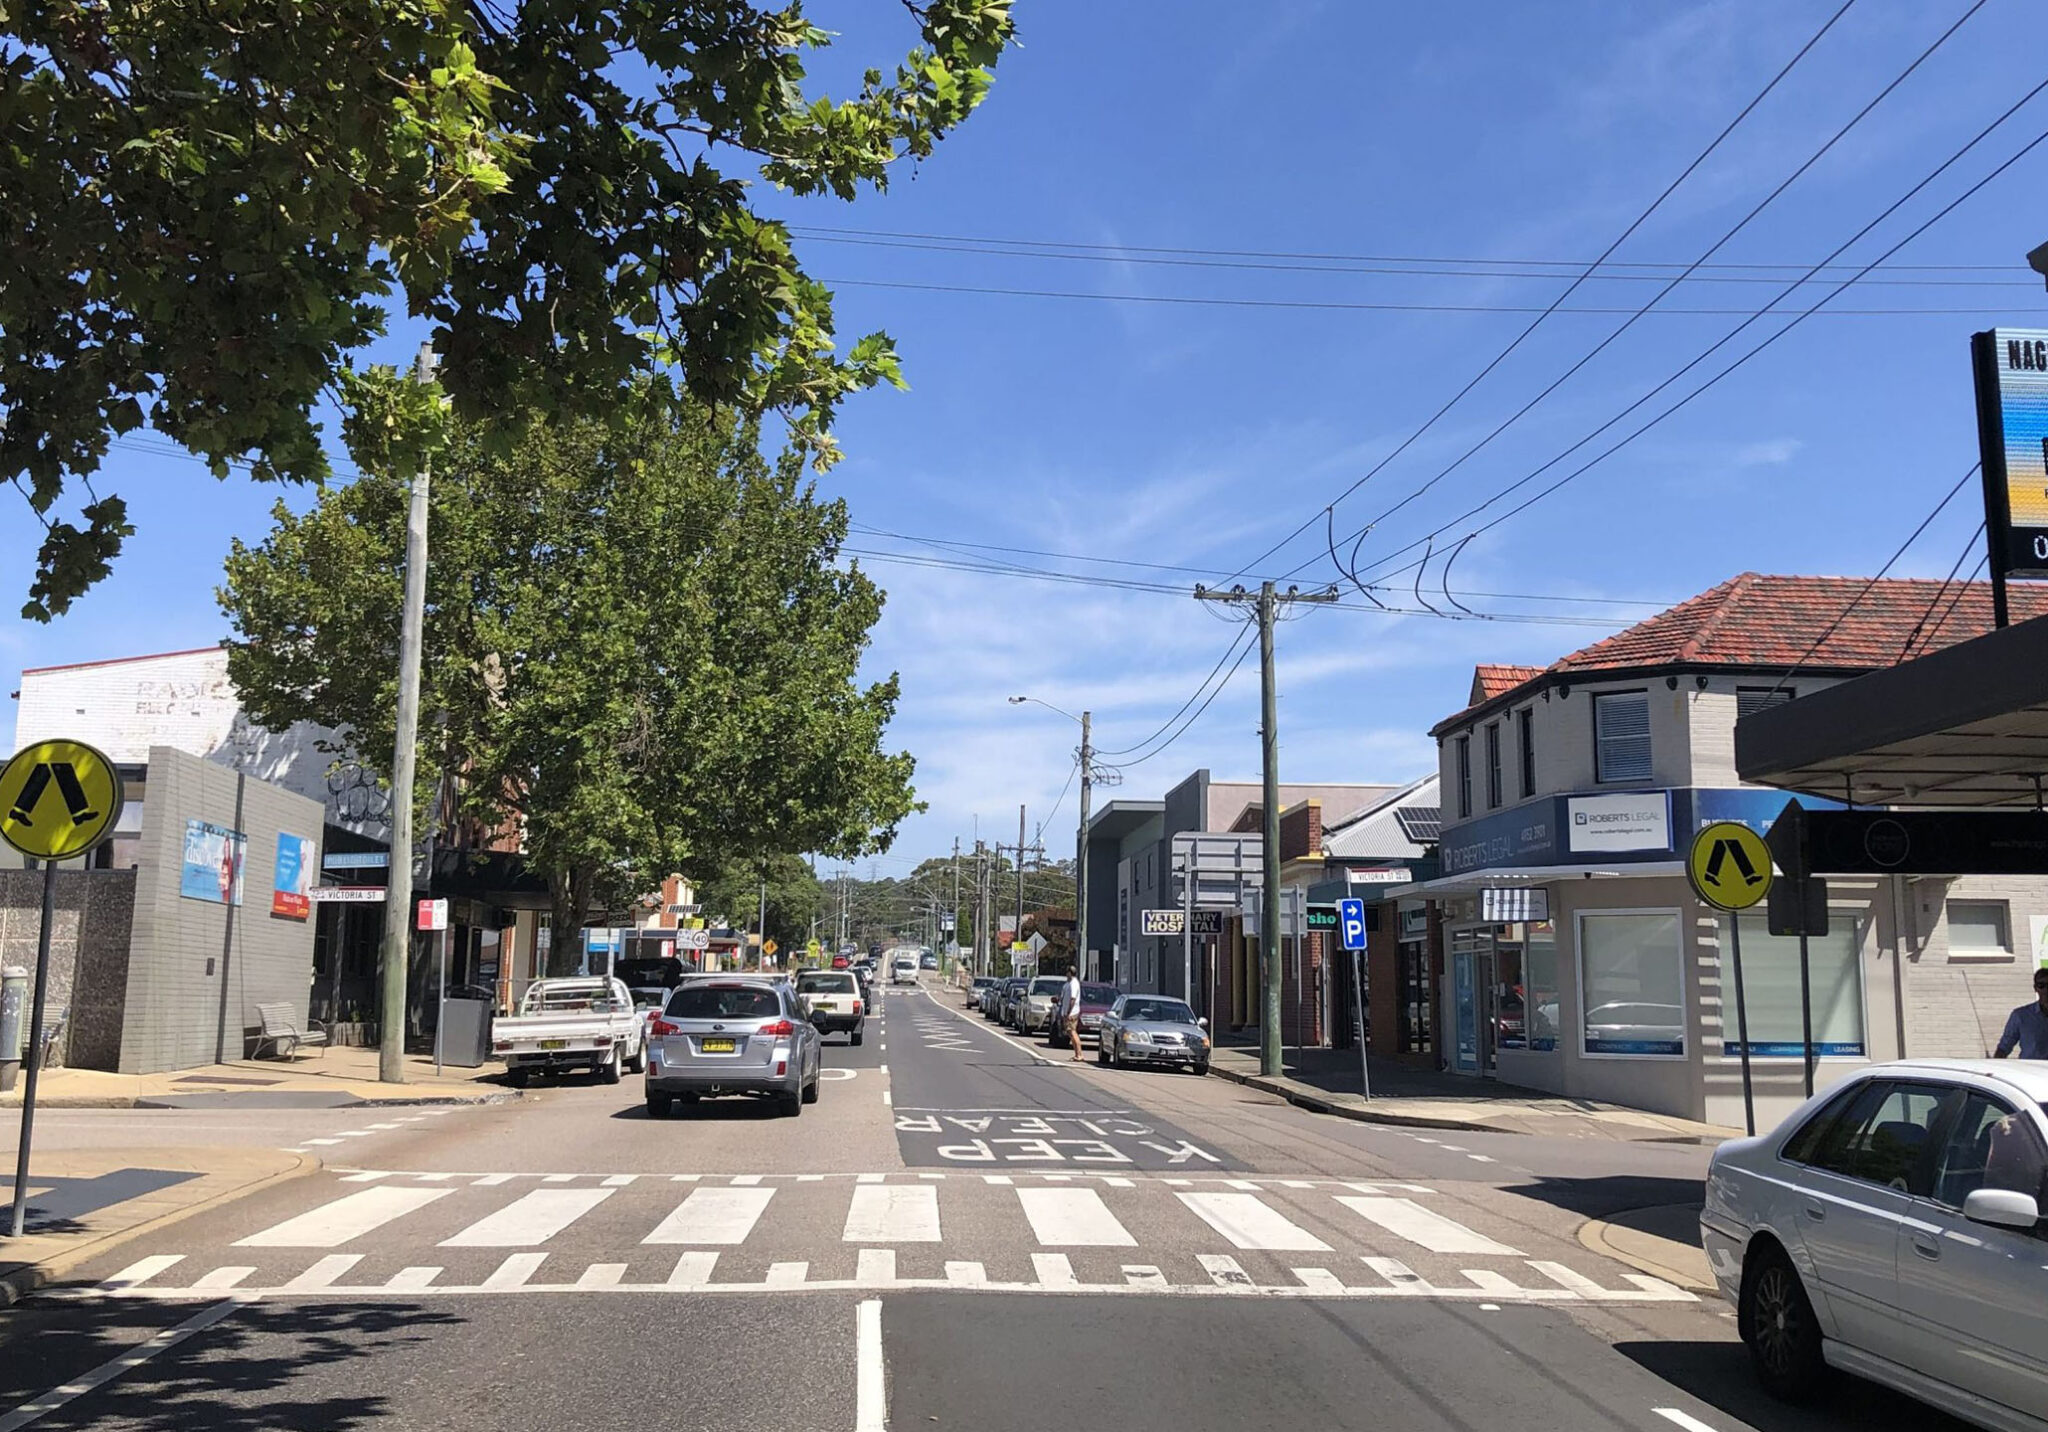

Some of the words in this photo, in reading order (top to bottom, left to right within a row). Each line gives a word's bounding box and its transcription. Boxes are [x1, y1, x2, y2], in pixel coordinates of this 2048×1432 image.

[2007, 339, 2048, 372] NAG
[1589, 812, 1630, 823] ROBERTS
[1631, 811, 1661, 822] LEGAL
[1454, 841, 1487, 869] ROBERTS
[1488, 834, 1515, 861] LEGAL
[1359, 872, 1386, 881] VICTORIA
[328, 891, 363, 899] VICTORIA
[367, 891, 376, 899] ST
[1147, 912, 1218, 922] VETERNARY
[1147, 921, 1219, 932] HOSPTAL
[1347, 920, 1362, 944] P
[695, 935, 707, 943] 40
[895, 1115, 1154, 1136] CLEAR
[937, 1138, 1221, 1163] KEEP
